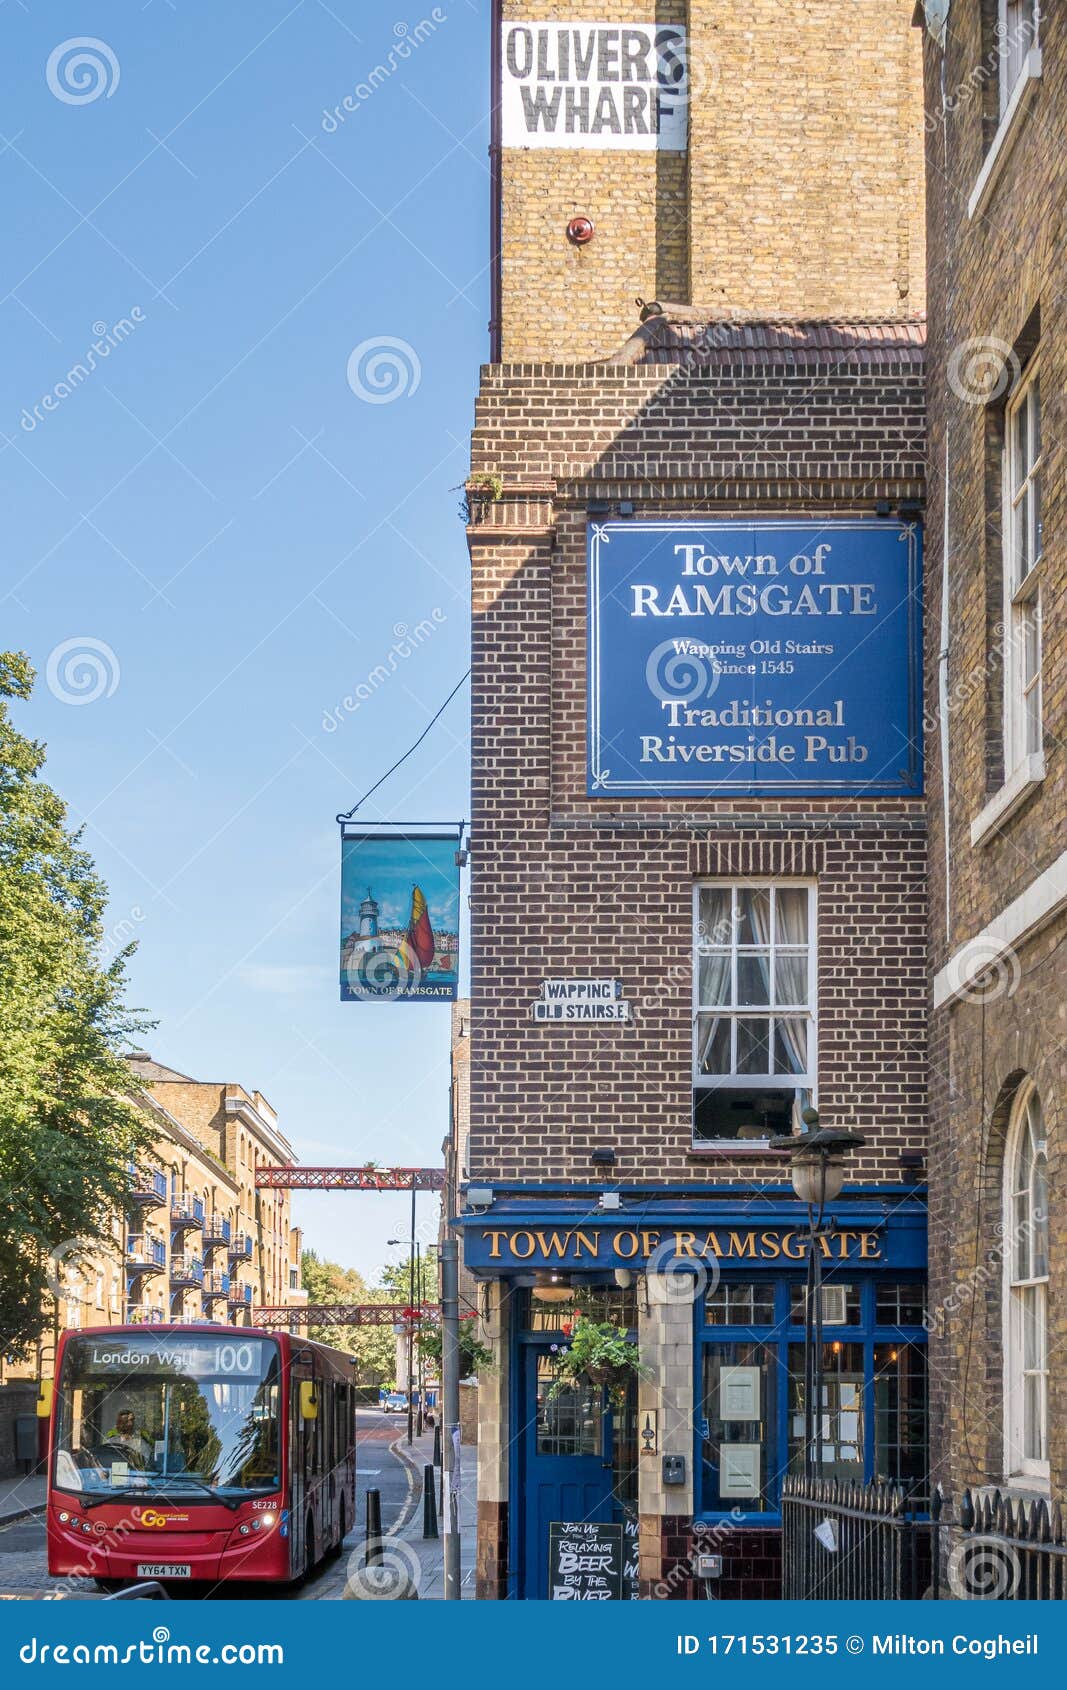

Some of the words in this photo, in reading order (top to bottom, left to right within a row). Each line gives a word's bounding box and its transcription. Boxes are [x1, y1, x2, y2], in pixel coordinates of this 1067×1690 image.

[506, 27, 684, 84] OLIVERS
[520, 85, 679, 134] WHARF
[675, 544, 779, 577] Town
[789, 543, 832, 576] of
[631, 584, 878, 617] RAMSGATE
[673, 640, 746, 658] Wapping
[750, 640, 782, 655] Old
[785, 640, 834, 655] Stairs
[712, 660, 756, 675] Since
[760, 660, 794, 675] 1545
[661, 699, 846, 727] Traditional
[639, 735, 796, 763] Riverside
[804, 735, 869, 763] Pub
[346, 986, 378, 995] TOWN
[380, 986, 395, 995] OF
[396, 986, 453, 996] RAMSGATE
[547, 983, 611, 999] WAPPING
[537, 1004, 563, 1018] OLD
[482, 1230, 600, 1258] TOWN
[613, 1230, 661, 1258] OF
[672, 1230, 882, 1259] RAMSGATE
[93, 1349, 150, 1365] London
[156, 1350, 194, 1366] Wall
[215, 1345, 253, 1372] 100
[252, 1501, 278, 1509] SE228
[558, 1540, 613, 1553] RELAXING
[141, 1566, 166, 1576] YY64
[169, 1566, 188, 1576] TXN
[558, 1552, 618, 1575] BEER
[563, 1575, 582, 1586] BY
[585, 1575, 608, 1587] THE
